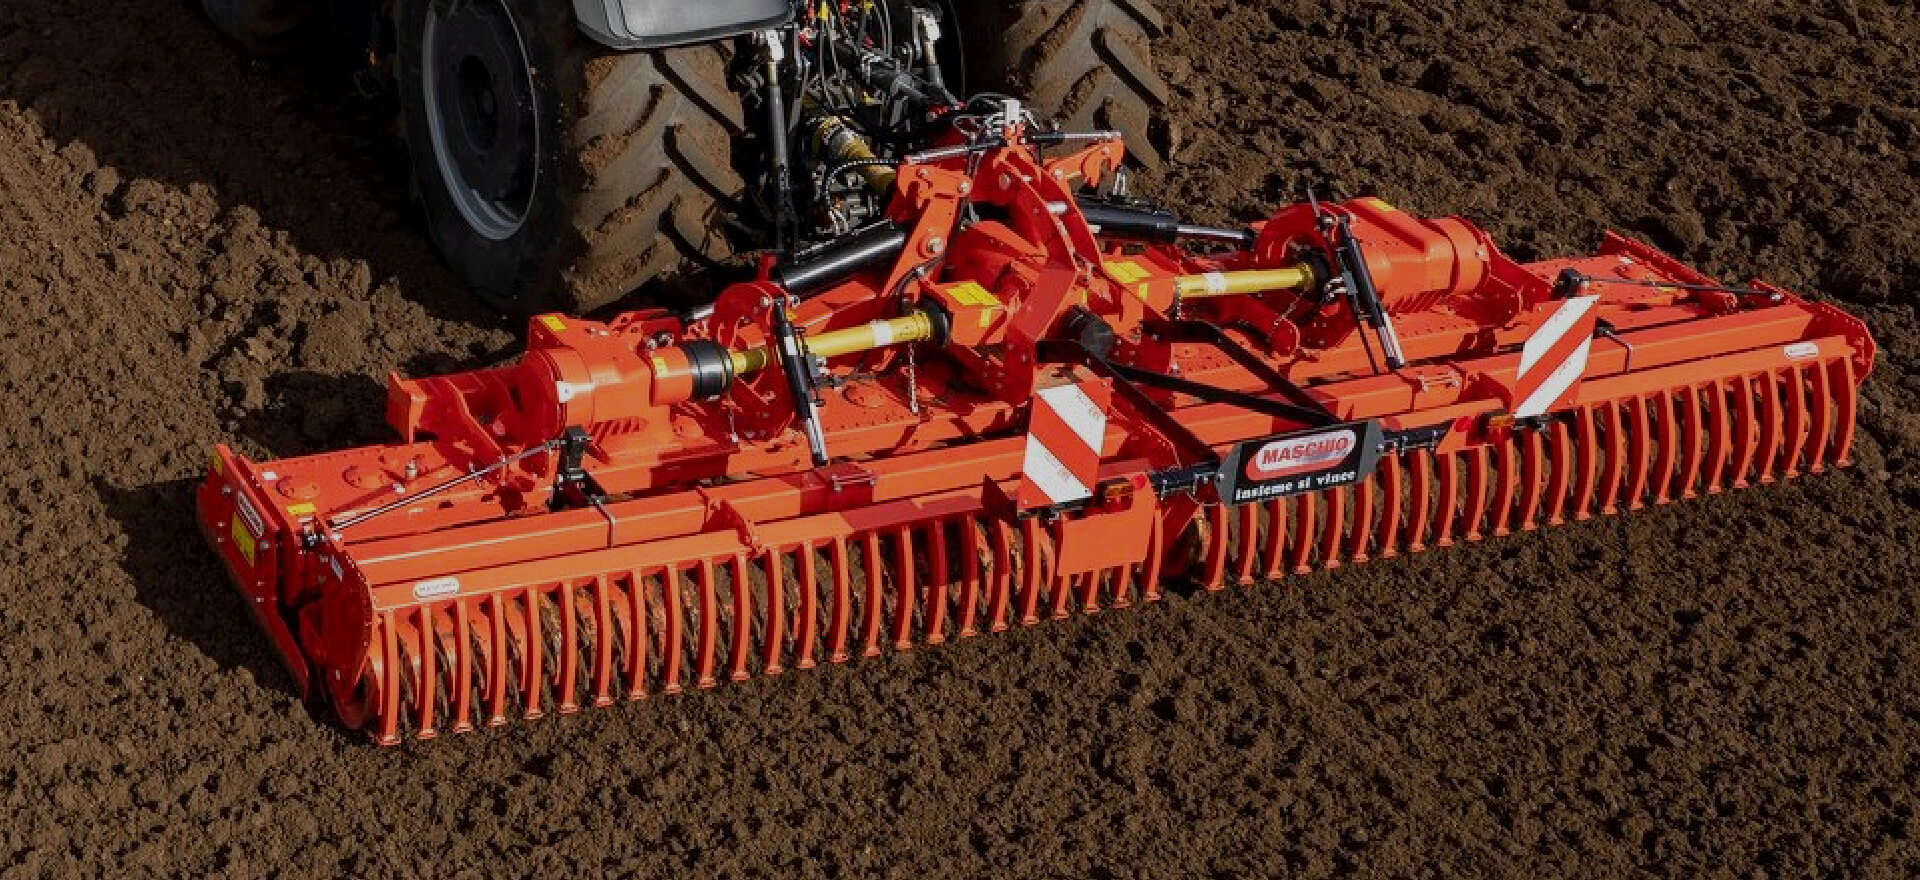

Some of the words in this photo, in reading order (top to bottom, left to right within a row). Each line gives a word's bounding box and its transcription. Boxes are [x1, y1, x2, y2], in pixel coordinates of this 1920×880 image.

[1261, 437, 1349, 465] MASCHIO
[1297, 475, 1311, 489] si
[1316, 470, 1356, 485] vince
